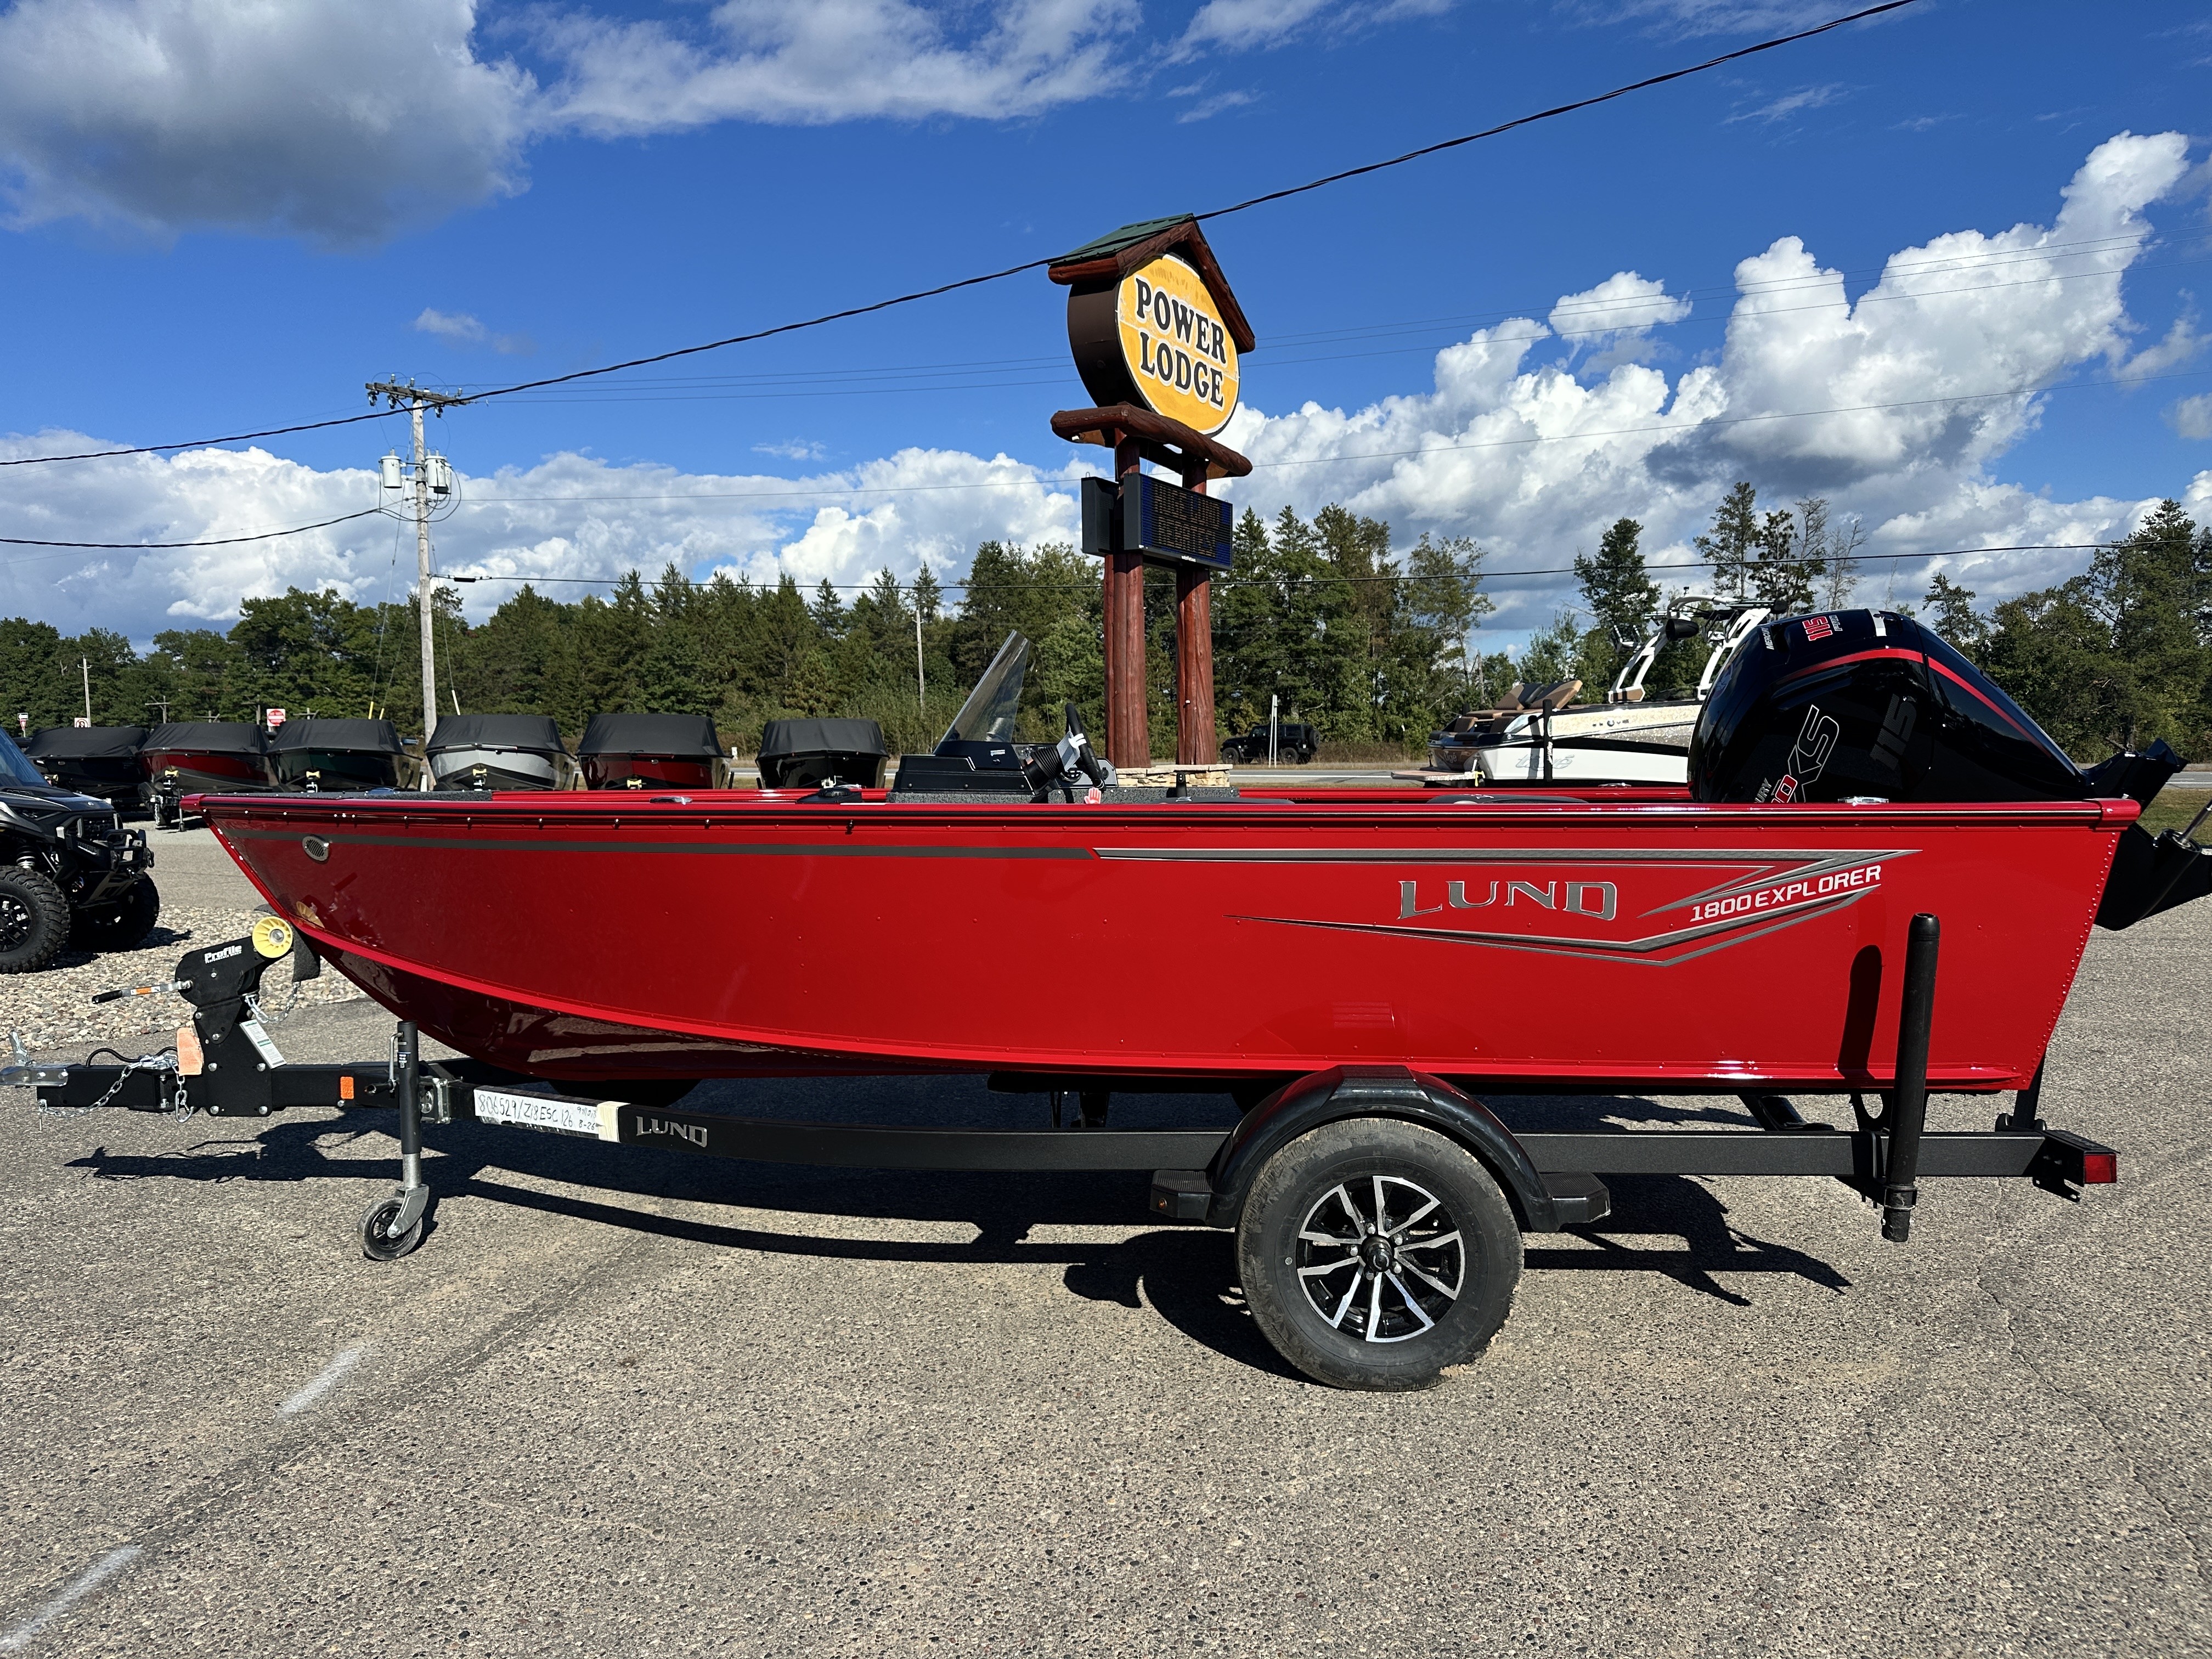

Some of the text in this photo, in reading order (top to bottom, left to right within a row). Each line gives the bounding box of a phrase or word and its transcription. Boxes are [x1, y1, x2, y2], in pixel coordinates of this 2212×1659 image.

[1135, 278, 1226, 364] POWER
[1139, 332, 1223, 408] LODGE
[1802, 616, 1833, 641] 115
[1870, 693, 1917, 771] 115
[1396, 881, 1618, 922] LUND
[1689, 865, 1882, 922] 1800 EXPLORER
[205, 945, 242, 961] Profile
[636, 1116, 708, 1148] LUND
